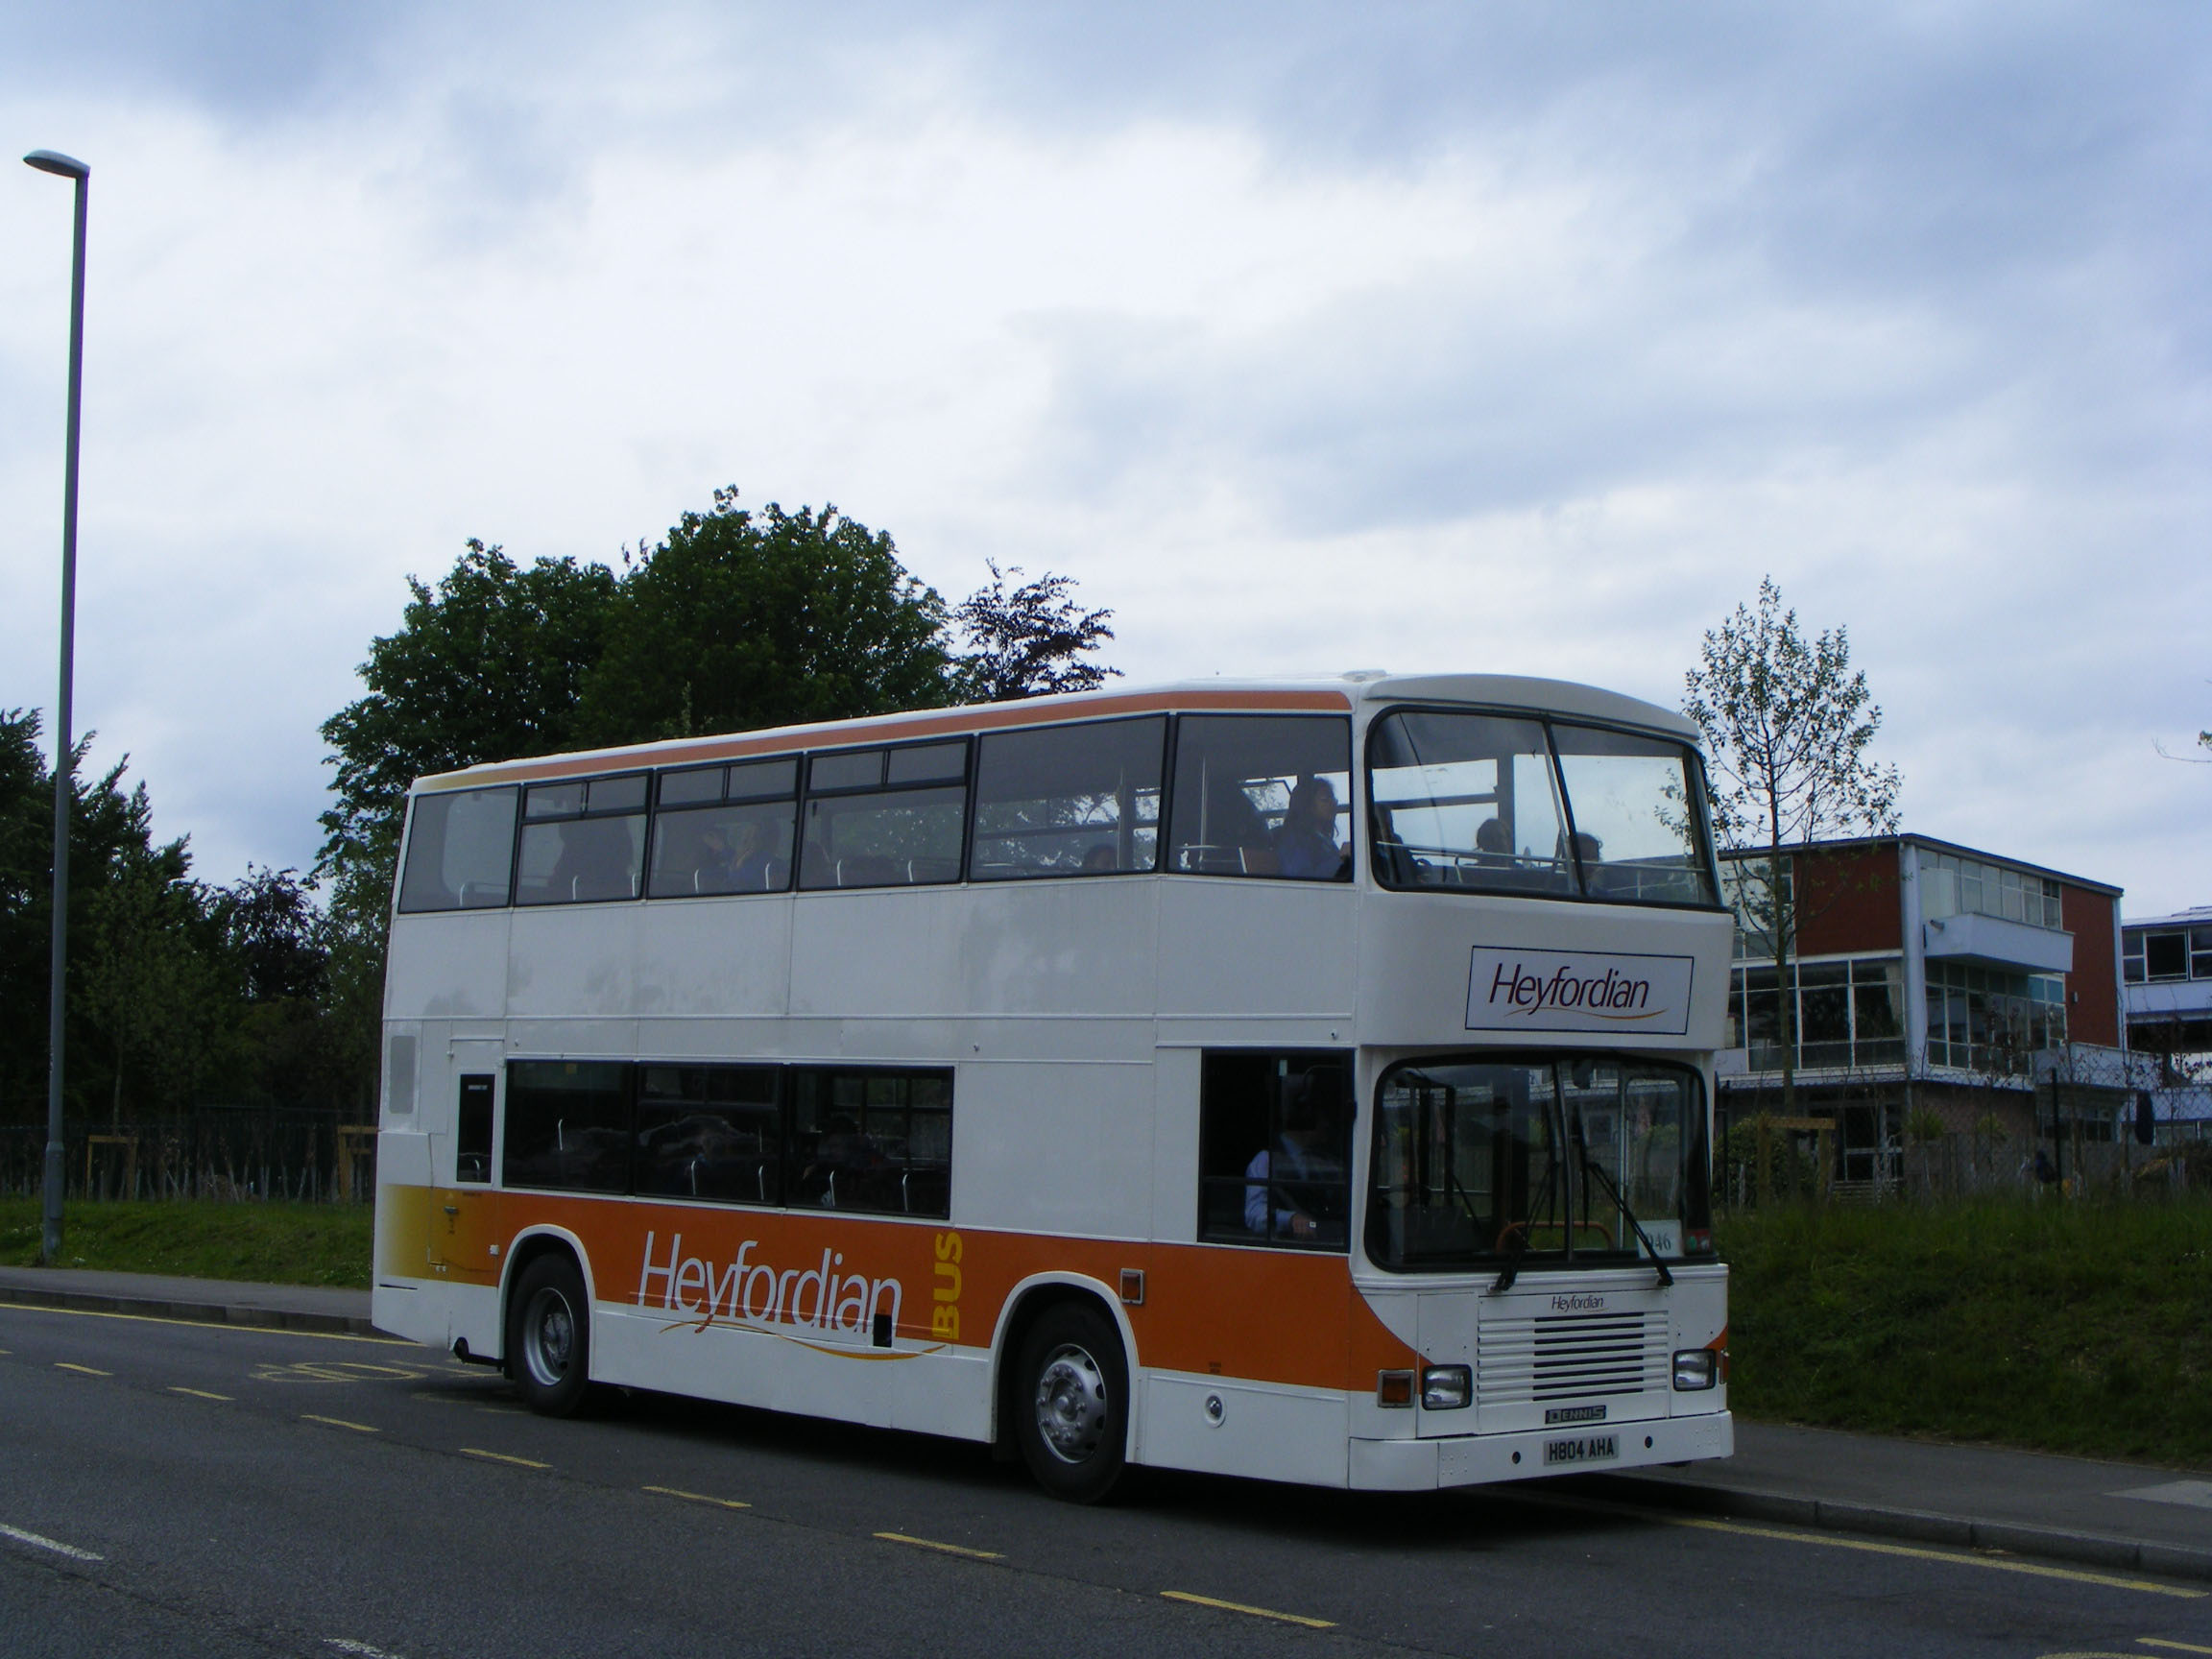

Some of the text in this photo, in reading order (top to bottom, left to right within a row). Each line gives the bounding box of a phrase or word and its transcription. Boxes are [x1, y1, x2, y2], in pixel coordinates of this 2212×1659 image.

[1489, 963, 1649, 1015] Heyfordian
[638, 1231, 902, 1337] Heyfordian
[932, 1232, 963, 1339] BUS
[1551, 1295, 1604, 1312] Heyfordian
[1548, 1407, 1604, 1423] DENNIS
[1549, 1437, 1614, 1461] H804 AHA
